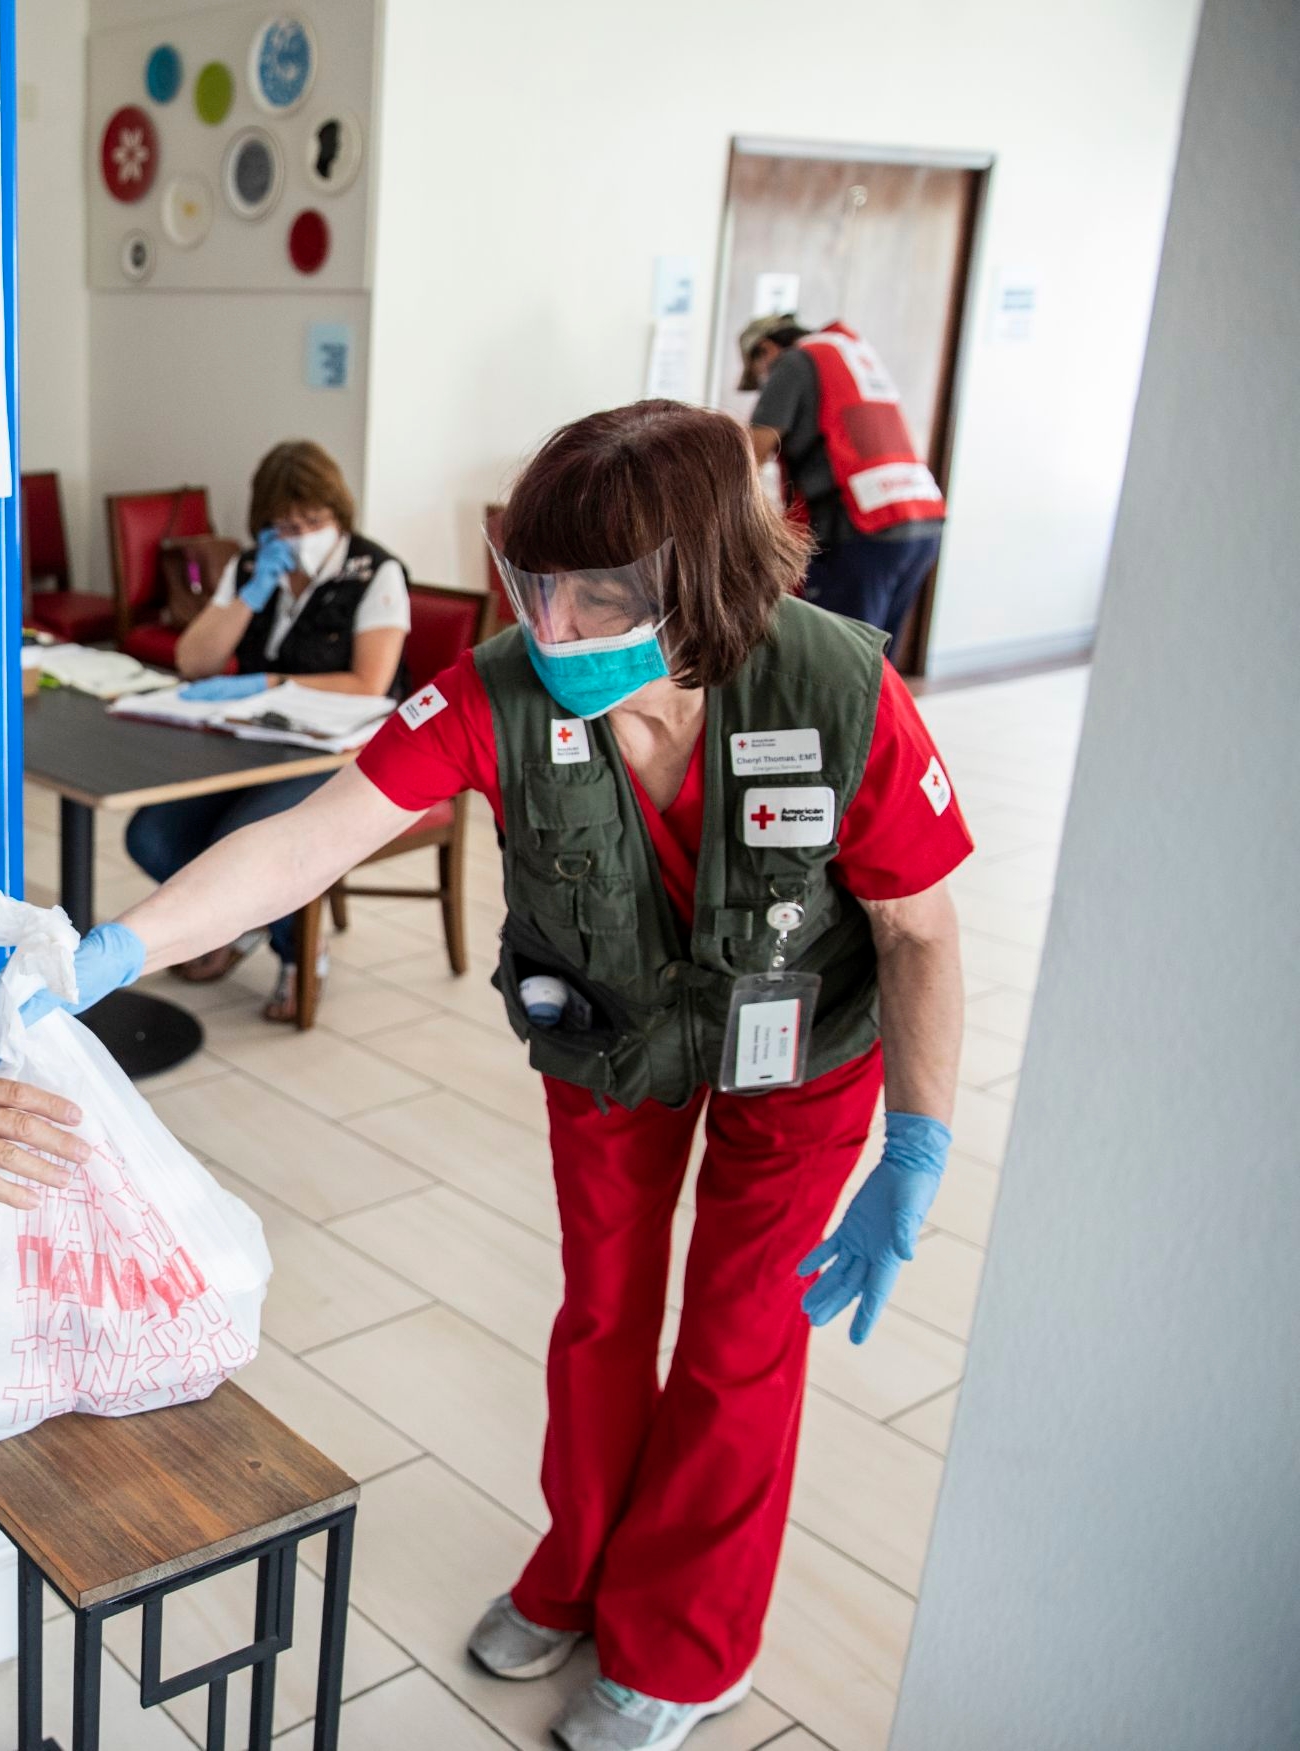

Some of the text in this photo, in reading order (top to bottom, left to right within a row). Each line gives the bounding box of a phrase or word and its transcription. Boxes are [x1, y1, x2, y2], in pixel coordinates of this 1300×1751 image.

[736, 756, 762, 765] Cheryl
[799, 752, 817, 761] EMT
[781, 807, 824, 815] American
[781, 814, 824, 822] Red Cross
